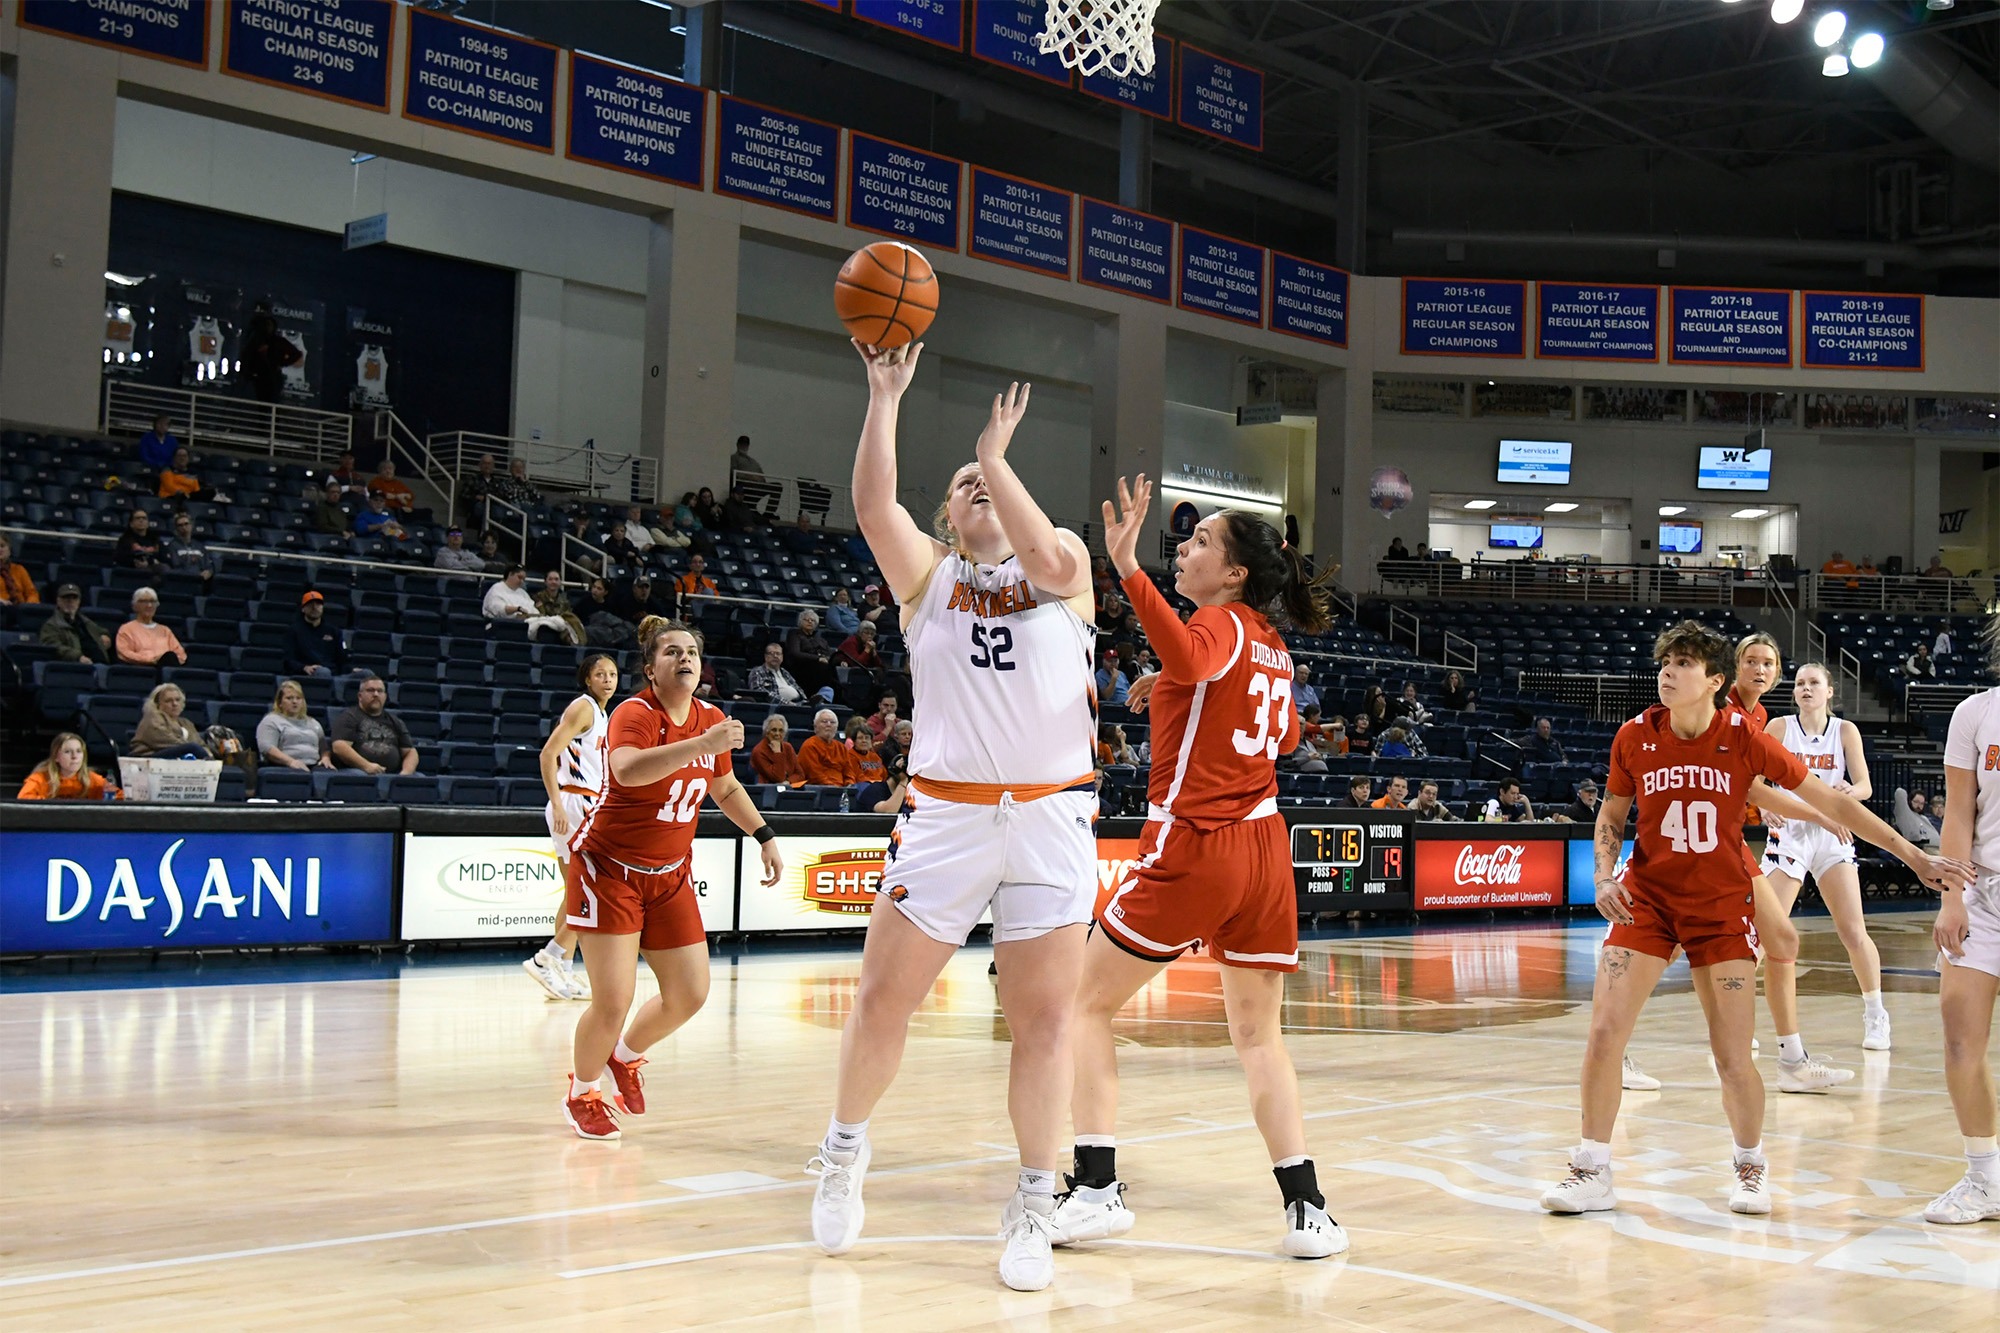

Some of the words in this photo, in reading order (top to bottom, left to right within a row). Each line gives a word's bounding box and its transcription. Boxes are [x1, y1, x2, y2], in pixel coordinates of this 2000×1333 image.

[933, 3, 944, 15] 32
[314, 10, 374, 38] LEAGUE
[897, 12, 923, 28] 19-15
[1017, 12, 1033, 25] NIT
[99, 18, 134, 38] 21-9
[241, 10, 314, 41] REGULAR
[318, 31, 379, 58] SEASON
[993, 24, 1027, 43] ROUND
[264, 38, 354, 72] CHAMPIONS
[460, 36, 508, 60] 1994-95
[1012, 50, 1036, 67] 17-14
[294, 66, 324, 84] 23-6
[426, 49, 482, 74] PATRIOT
[486, 65, 539, 90] LEAGUE
[1213, 64, 1232, 78] 2018
[420, 70, 485, 98] REGULAR
[489, 89, 543, 113] SEASON
[616, 76, 663, 98] 2004-05
[1143, 81, 1155, 93] NY
[1211, 77, 1233, 93] NCAA
[1118, 87, 1136, 101] 26-9
[1196, 85, 1225, 104] ROUND
[1226, 97, 1237, 108] OF
[1239, 100, 1248, 112] 64
[586, 85, 639, 109] PATRIOT
[642, 100, 691, 124] LEAGUE
[428, 96, 533, 132] CO-CHAMPIONS
[594, 105, 681, 138] TOURNAMENT
[1235, 113, 1245, 125] MI
[761, 117, 799, 135] 2005-06
[1212, 118, 1232, 134] 25-10
[600, 125, 675, 154] CHAMPIONS
[736, 124, 780, 144] PATRIOT
[782, 137, 822, 156] LEAGUE
[624, 150, 649, 166] 24-9
[746, 141, 813, 167] UNDEFEATED
[888, 153, 926, 172] 2006-07
[731, 152, 780, 173] REGULAR
[784, 165, 825, 185] SEASON
[770, 176, 787, 187] AND
[863, 161, 907, 182] PATRIOT
[909, 175, 948, 194] LEAGUE
[725, 175, 780, 196] TOURNAMENT
[782, 190, 831, 209] CHAMPIONS
[860, 177, 907, 199] REGULAR
[910, 190, 952, 210] SEASON
[1006, 185, 1040, 202] 2010-11
[864, 195, 945, 225] CO-CHAMPIONS
[983, 194, 1022, 213] PATRIOT
[1025, 206, 1061, 224] LEAGUE
[894, 219, 915, 233] 22-9
[980, 209, 1024, 230] REGULAR
[1026, 222, 1063, 240] SEASON
[1112, 214, 1144, 231] 2011-12
[1014, 235, 1029, 244] AND
[1091, 228, 1127, 245] PATRIOT
[1130, 238, 1163, 256] LEAGUE
[975, 236, 1023, 255] TOURNAMENT
[1025, 249, 1067, 266] CHAMPIONS
[1208, 245, 1237, 261] 2012-13
[1088, 246, 1129, 265] REGULAR
[1131, 257, 1165, 275] SEASON
[1190, 255, 1223, 272] PATRIOT
[1225, 265, 1255, 281] LEAGUE
[1101, 268, 1152, 290] CHAMPIONS
[1187, 269, 1224, 287] REGULAR
[1226, 279, 1258, 296] SEASON
[1298, 267, 1324, 282] 2014-15
[1216, 291, 1228, 299] AND
[1281, 279, 1311, 295] PATRIOT
[1313, 288, 1341, 303] LEAGUE
[1444, 287, 1485, 297] 2015-16
[1578, 291, 1620, 301] 2016-17
[1183, 292, 1223, 309] TOURNAMENT
[1278, 296, 1312, 312] REGULAR
[1314, 304, 1343, 320] SEASON
[1417, 302, 1464, 312] PATRIOT
[1467, 304, 1512, 314] LEAGUE
[1711, 296, 1752, 306] 2017-18
[1842, 301, 1884, 311] 2018-19
[272, 306, 314, 321] CREAMER
[1552, 304, 1598, 314] PATRIOT
[1602, 305, 1646, 316] LEAGUE
[1684, 309, 1731, 319] PATRIOT
[1734, 310, 1779, 320] LEAGUE
[1816, 312, 1862, 322] PATRIOT
[1866, 314, 1911, 324] LEAGUE
[353, 320, 392, 336] MUSCALA
[1288, 316, 1332, 335] CHAMPIONS
[1413, 320, 1466, 329] REGULAR
[1469, 321, 1515, 331] SEASON
[1548, 317, 1600, 328] REGULAR
[1604, 319, 1650, 330] SEASON
[1681, 322, 1733, 332] REGULAR
[1737, 324, 1782, 334] SEASON
[1812, 325, 1865, 336] REGULAR
[1868, 328, 1914, 337] SEASON
[1430, 337, 1498, 348] CHAMPIONS
[1543, 340, 1601, 349] TOURNAMENT
[1603, 342, 1653, 351] CHAMPIONS
[1677, 345, 1734, 353] TOURNAMENT
[1736, 346, 1786, 355] CHAMPIONS
[1819, 338, 1908, 350] CO-CHAMPIONS
[1849, 353, 1878, 362] 21-12
[1331, 487, 1340, 496] M
[971, 623, 1015, 670] 52
[1231, 672, 1292, 760] 33
[1642, 765, 1731, 796] BOSTON
[656, 778, 708, 822] 10
[1369, 824, 1403, 838] VISITOR
[1660, 800, 1718, 854] 40
[1310, 830, 1358, 860] 7:16
[1384, 848, 1401, 878] 19
[1454, 844, 1525, 885] Coca-Cola
[460, 863, 555, 881] MID-PENN
[1312, 867, 1330, 878] POSS
[1344, 869, 1352, 890] 2
[46, 838, 321, 938] DASANI
[489, 885, 528, 894] ENERGY
[816, 871, 882, 894] SHE
[1308, 882, 1333, 893] PERIOD
[1364, 883, 1386, 894] BONUS
[1424, 894, 1445, 906] proud
[1447, 894, 1480, 905] supporter
[1482, 893, 1489, 903] of
[1491, 892, 1518, 903] Bucknell
[1520, 891, 1552, 903] University
[478, 914, 555, 926] mid-pennene
